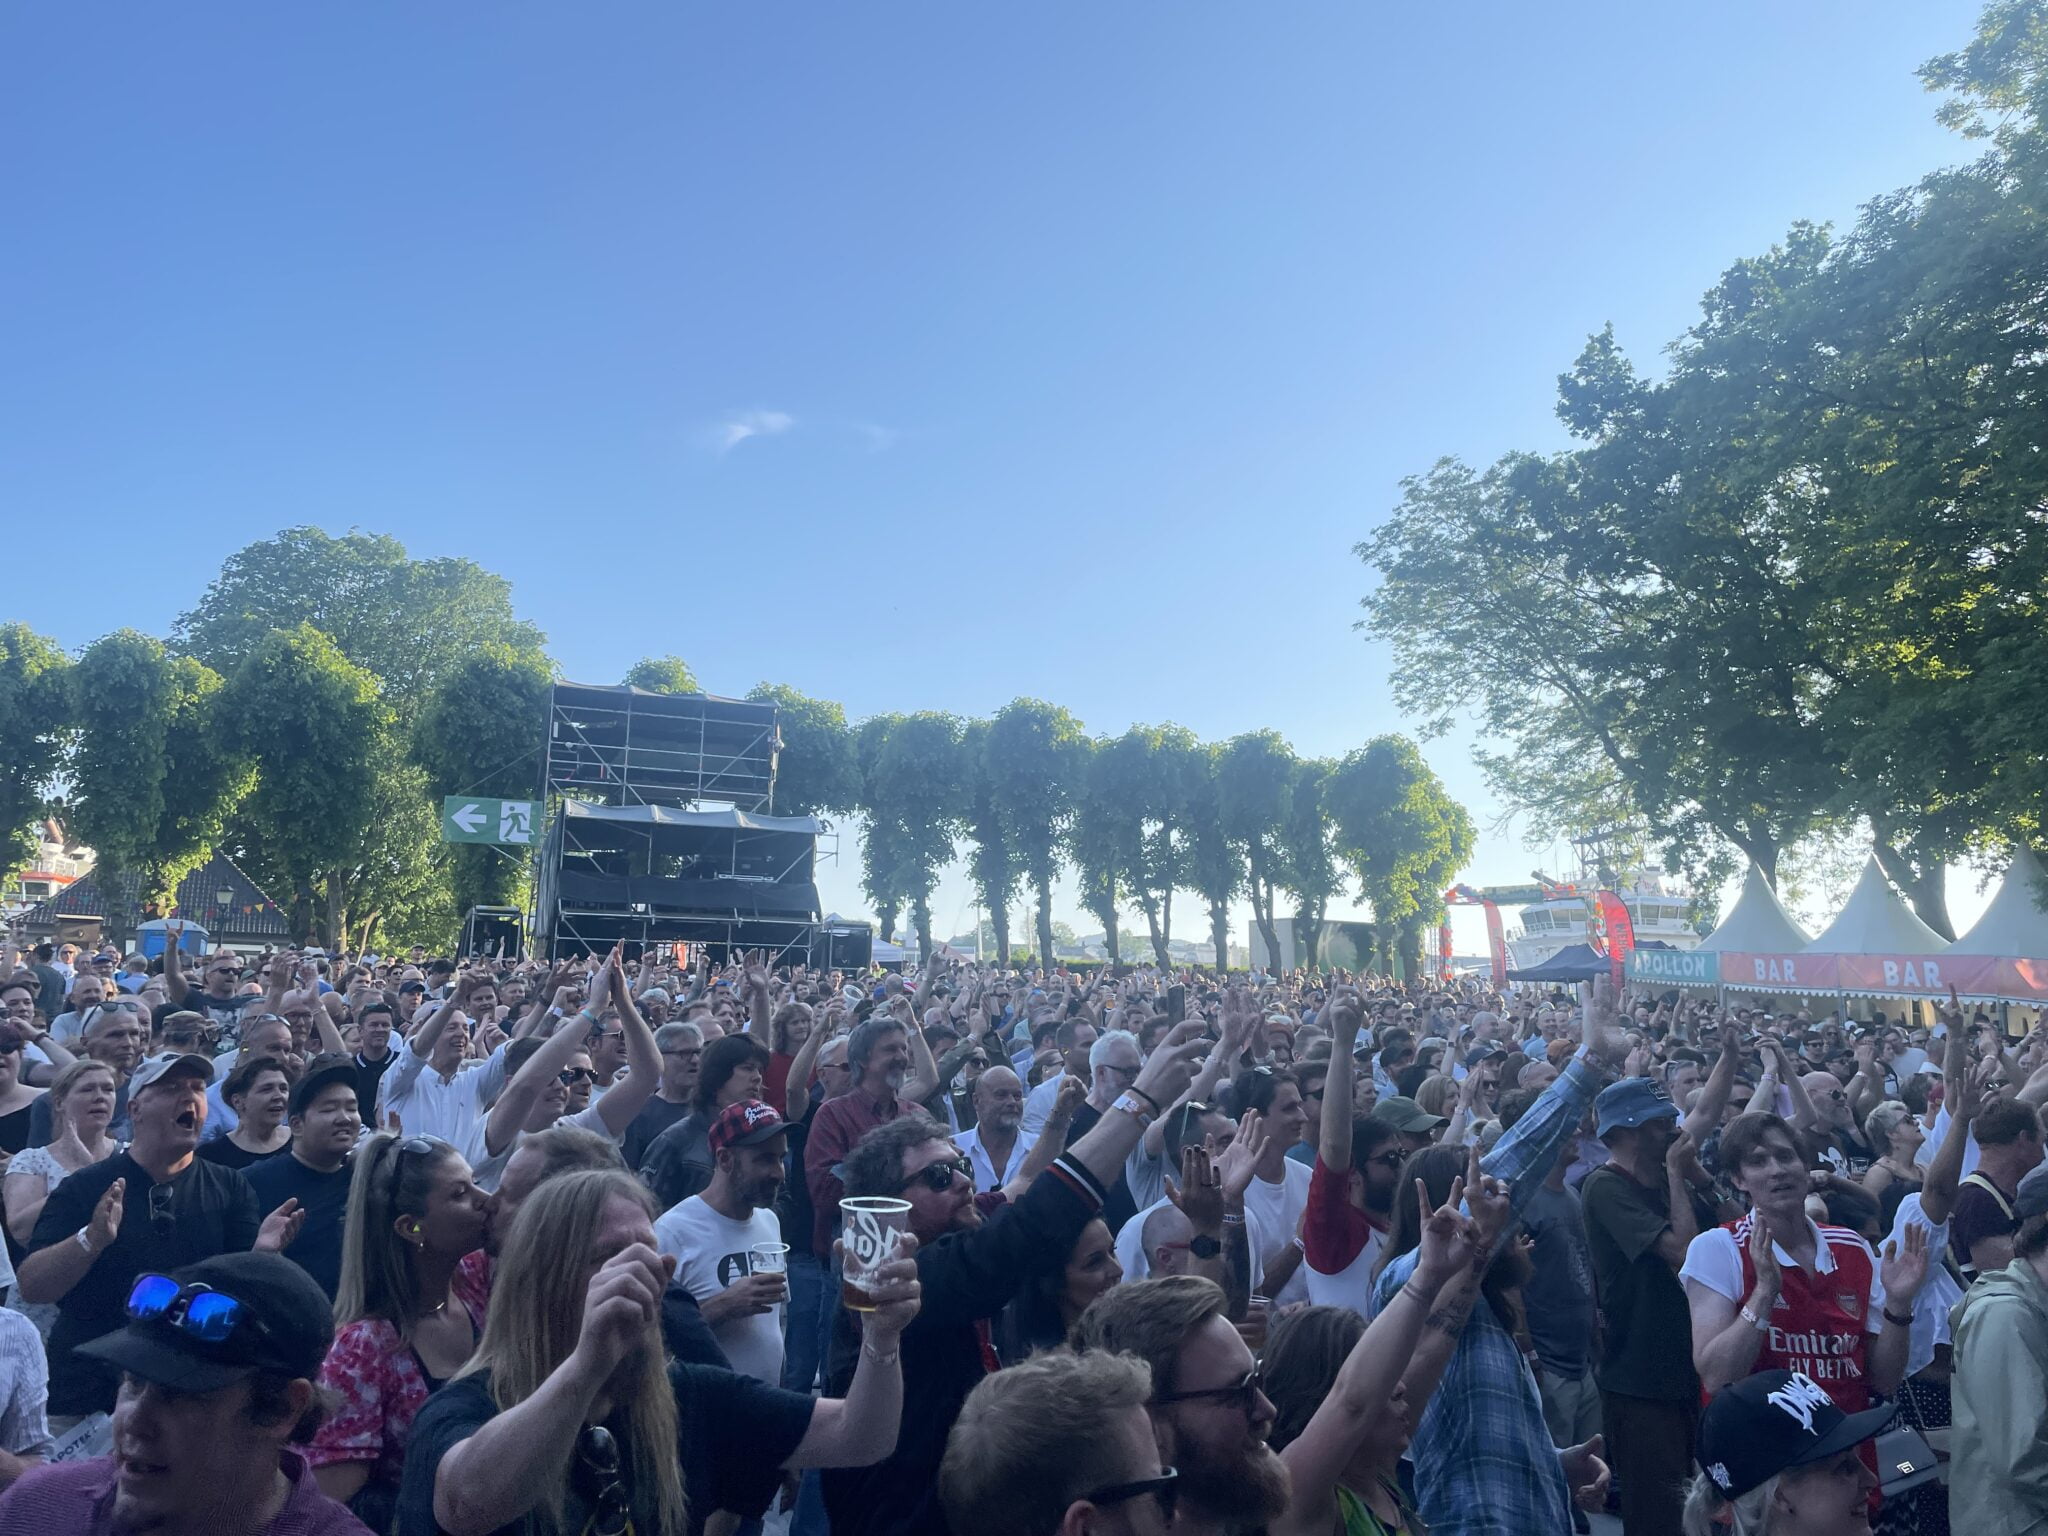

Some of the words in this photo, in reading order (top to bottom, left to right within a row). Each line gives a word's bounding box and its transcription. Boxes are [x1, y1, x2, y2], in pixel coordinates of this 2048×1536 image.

[1633, 953, 1705, 977] APOLLON
[1754, 957, 1796, 983] BAR
[1883, 959, 1943, 989] BAR
